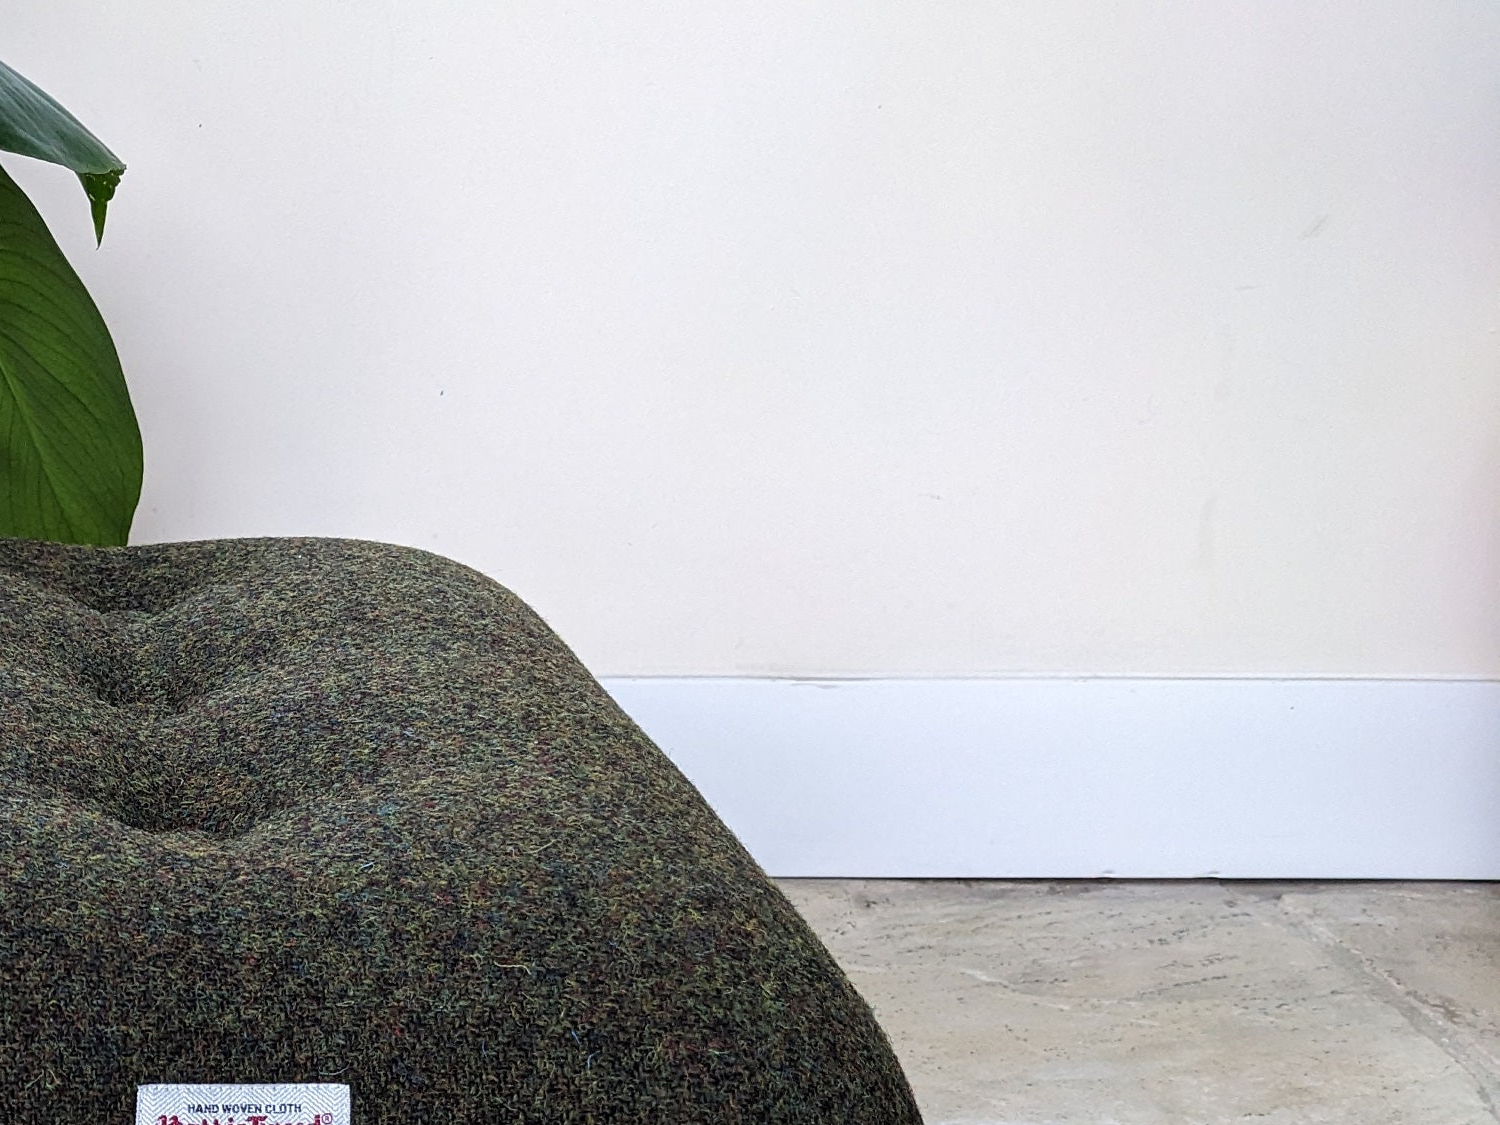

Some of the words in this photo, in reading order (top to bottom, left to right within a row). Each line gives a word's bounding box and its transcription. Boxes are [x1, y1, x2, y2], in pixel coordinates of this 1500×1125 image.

[187, 1103, 219, 1113] HAND
[222, 1103, 262, 1114] WOVEN
[265, 1103, 301, 1113] CLOTH
